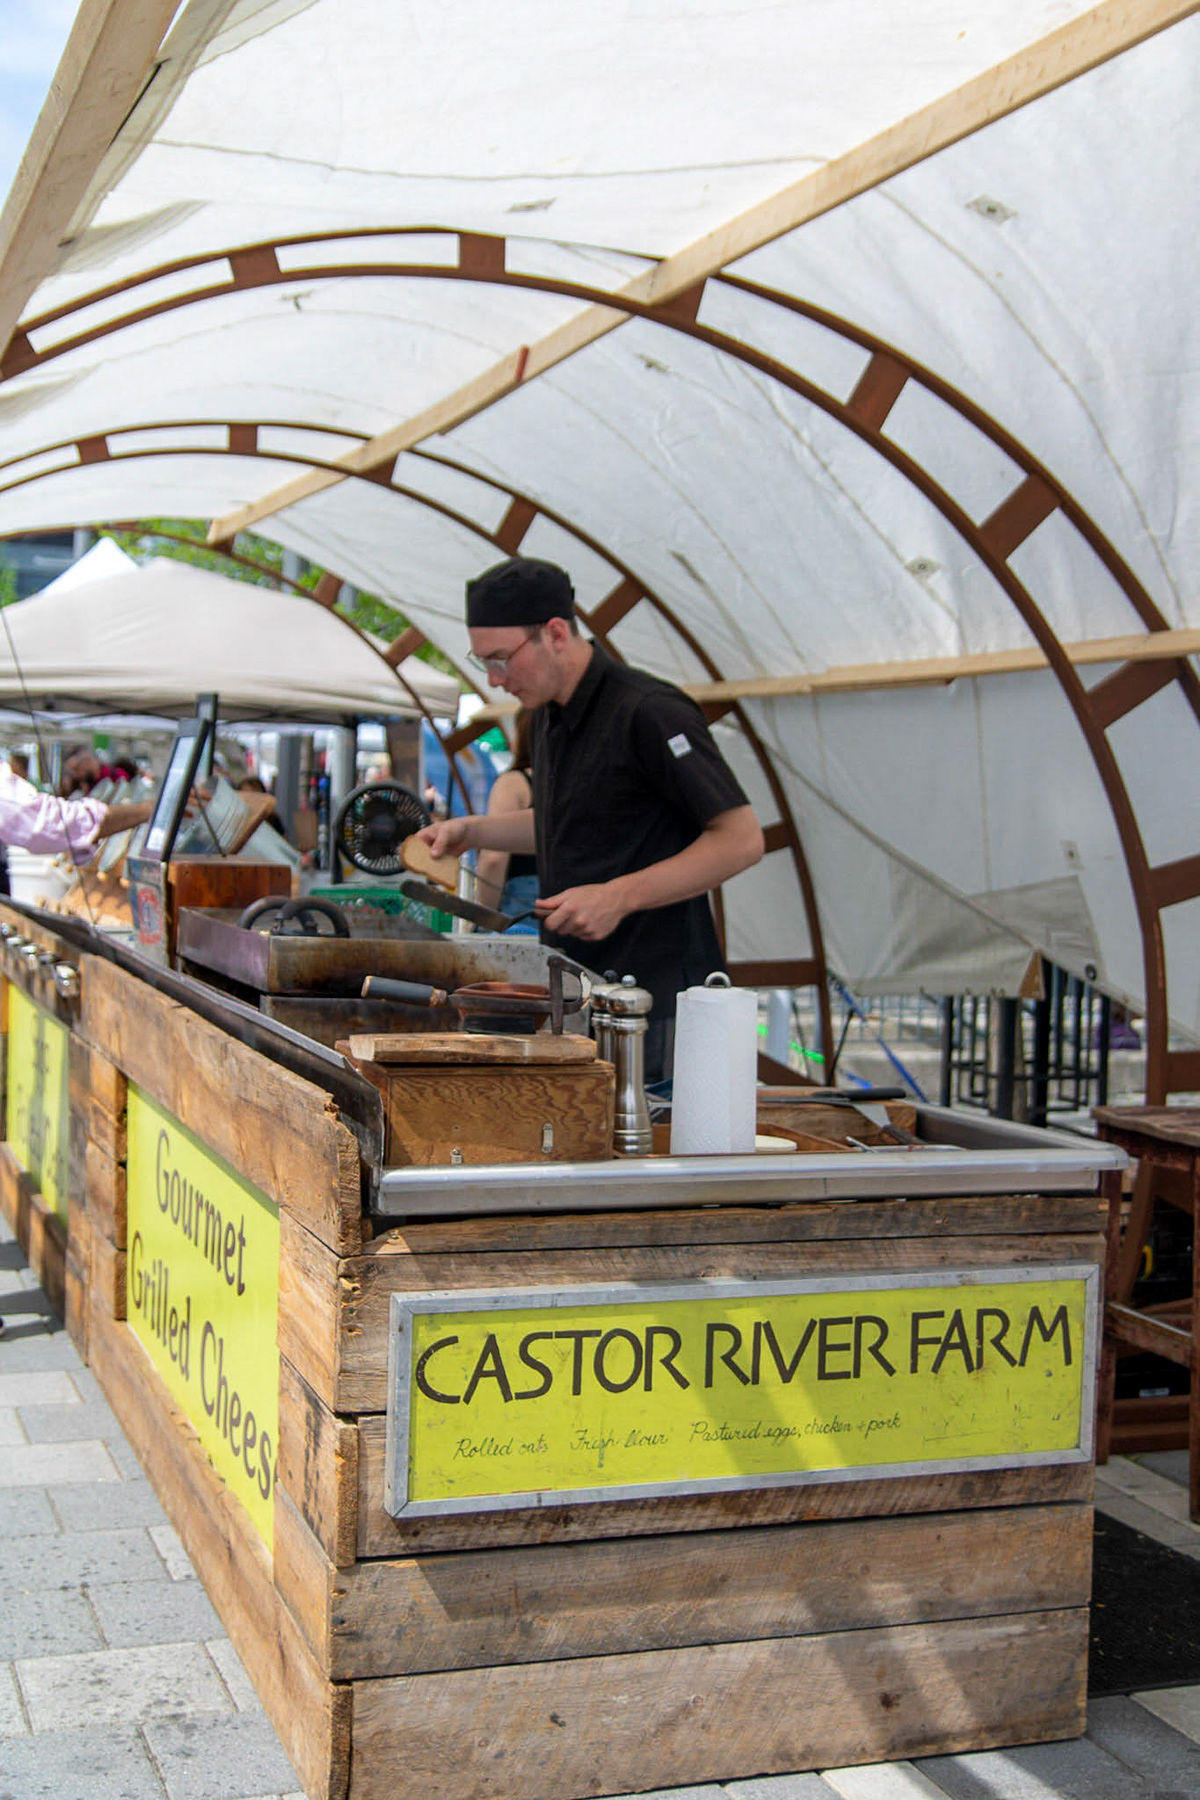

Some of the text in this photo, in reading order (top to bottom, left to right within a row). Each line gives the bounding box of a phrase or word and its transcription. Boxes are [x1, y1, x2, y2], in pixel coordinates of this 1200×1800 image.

[155, 1128, 246, 1296] Gourmet
[130, 1231, 279, 1500] Grilled Chees
[415, 1305, 1072, 1405] CASTOR RIVER FARM
[453, 1436, 513, 1460] Rolled
[689, 1420, 761, 1443] Pastured
[804, 1415, 851, 1435] chicken
[864, 1412, 901, 1440] pork
